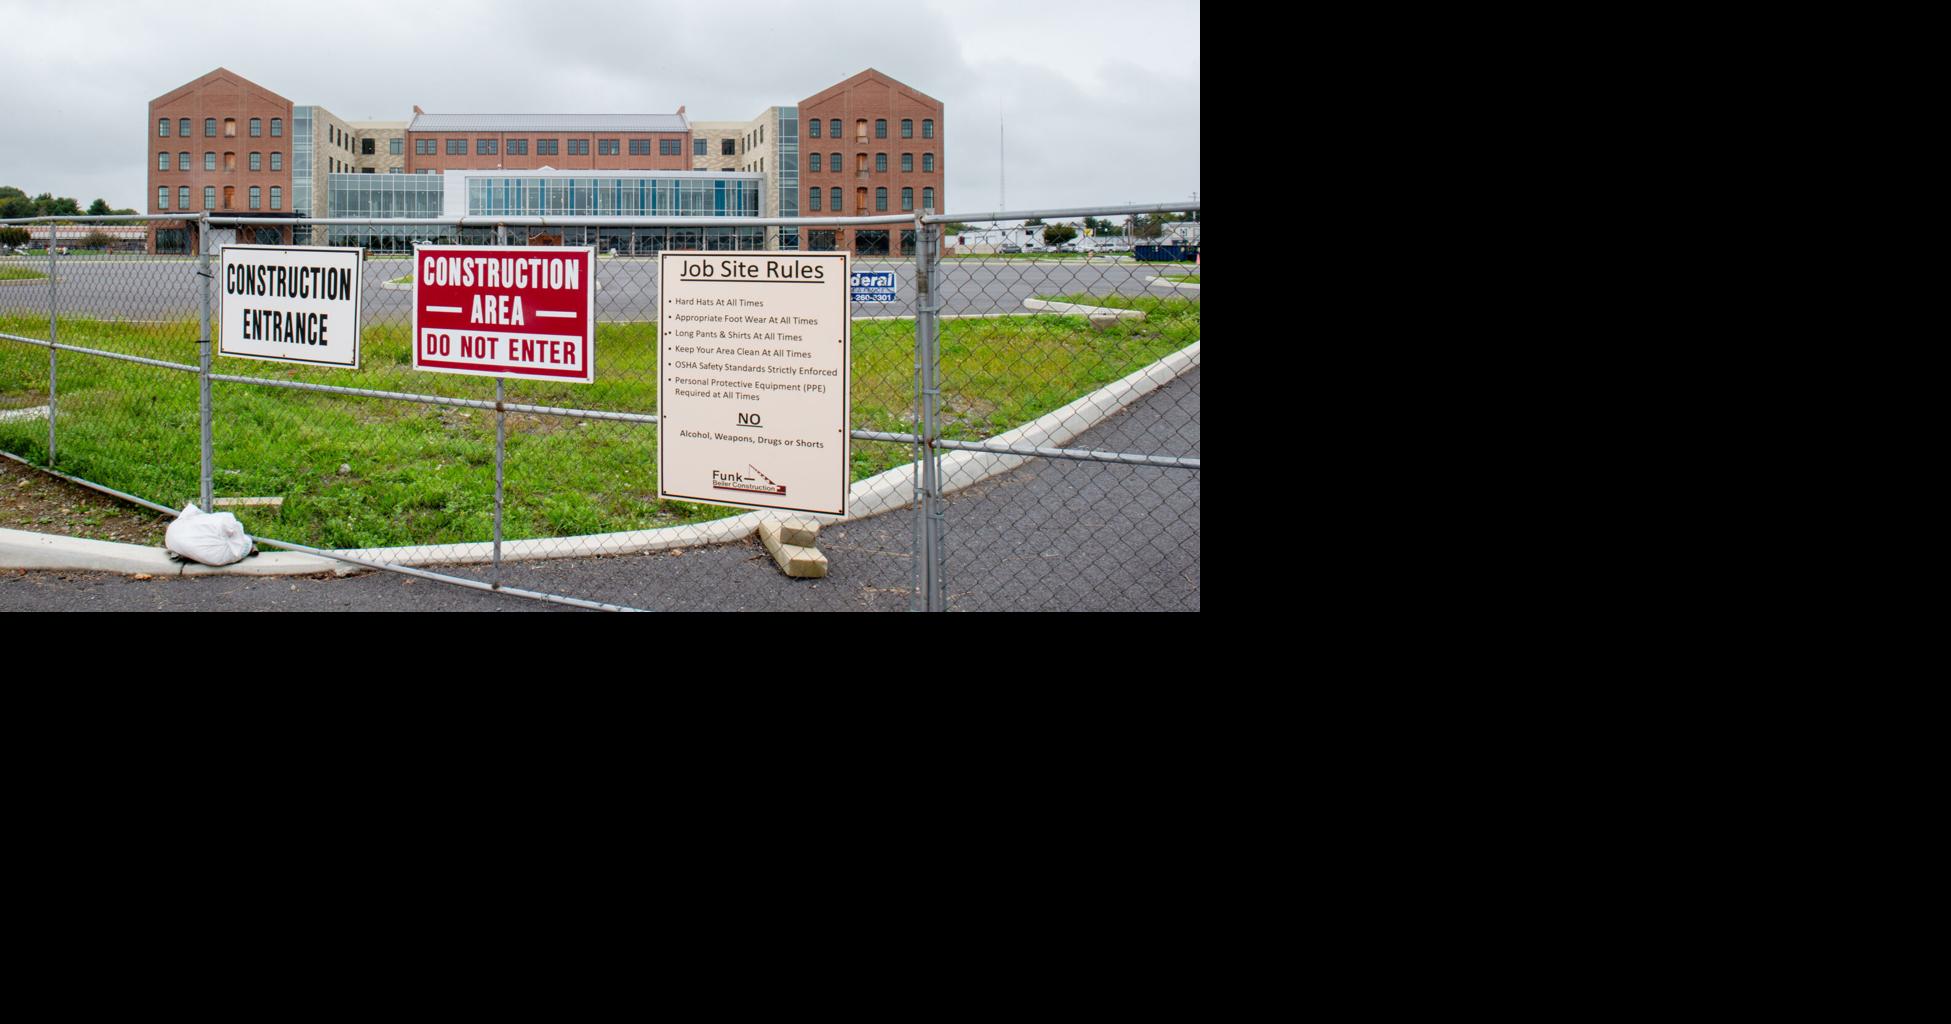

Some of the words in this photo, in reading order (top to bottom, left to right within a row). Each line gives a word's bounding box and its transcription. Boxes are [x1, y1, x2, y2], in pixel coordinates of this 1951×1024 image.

[423, 256, 579, 290] CONSTRUCTION
[680, 260, 714, 278] Job
[721, 261, 759, 278] Site
[767, 261, 824, 279] Rules
[227, 263, 351, 301] CONSTRUCTION
[471, 294, 525, 326] AREA
[675, 298, 694, 306] Hard
[726, 299, 737, 307] All
[740, 299, 764, 308] Times
[243, 308, 328, 346] ENTRANCE
[675, 314, 723, 324] Appropriate
[725, 315, 742, 323] Foot
[745, 316, 767, 324] Wear
[769, 316, 778, 324] At
[780, 317, 791, 325] All
[793, 317, 818, 325] Times
[675, 330, 694, 339] Long
[719, 331, 726, 339] &
[728, 331, 751, 339] Shirts
[753, 332, 763, 340] At
[778, 333, 803, 341] Times
[427, 334, 450, 356] DO
[461, 336, 498, 359] NOT
[509, 339, 576, 365] ENTER
[675, 346, 694, 354] Keep
[697, 346, 714, 354] Your
[716, 347, 735, 355] Area
[737, 348, 760, 356] Clean
[762, 349, 771, 357] At
[773, 349, 784, 357] All
[787, 350, 812, 358] Times
[675, 361, 697, 369] OSHA
[699, 362, 723, 371] Safety
[725, 364, 765, 373] Standards
[768, 366, 797, 375] Strictly
[800, 368, 837, 376] Enforced
[675, 377, 709, 386] Personal
[712, 379, 753, 388] Protective
[755, 381, 800, 392] Equipment
[803, 384, 826, 393] (PPE)
[675, 389, 711, 398] Required
[723, 391, 733, 399] All
[736, 392, 760, 401] Times
[738, 413, 761, 425] NO
[680, 430, 712, 440] Alcohol,
[715, 433, 755, 444] Weapons,
[758, 436, 782, 446] Drugs
[796, 440, 824, 449] Shorts
[713, 470, 743, 482] Funk
[732, 482, 776, 492] Construction
